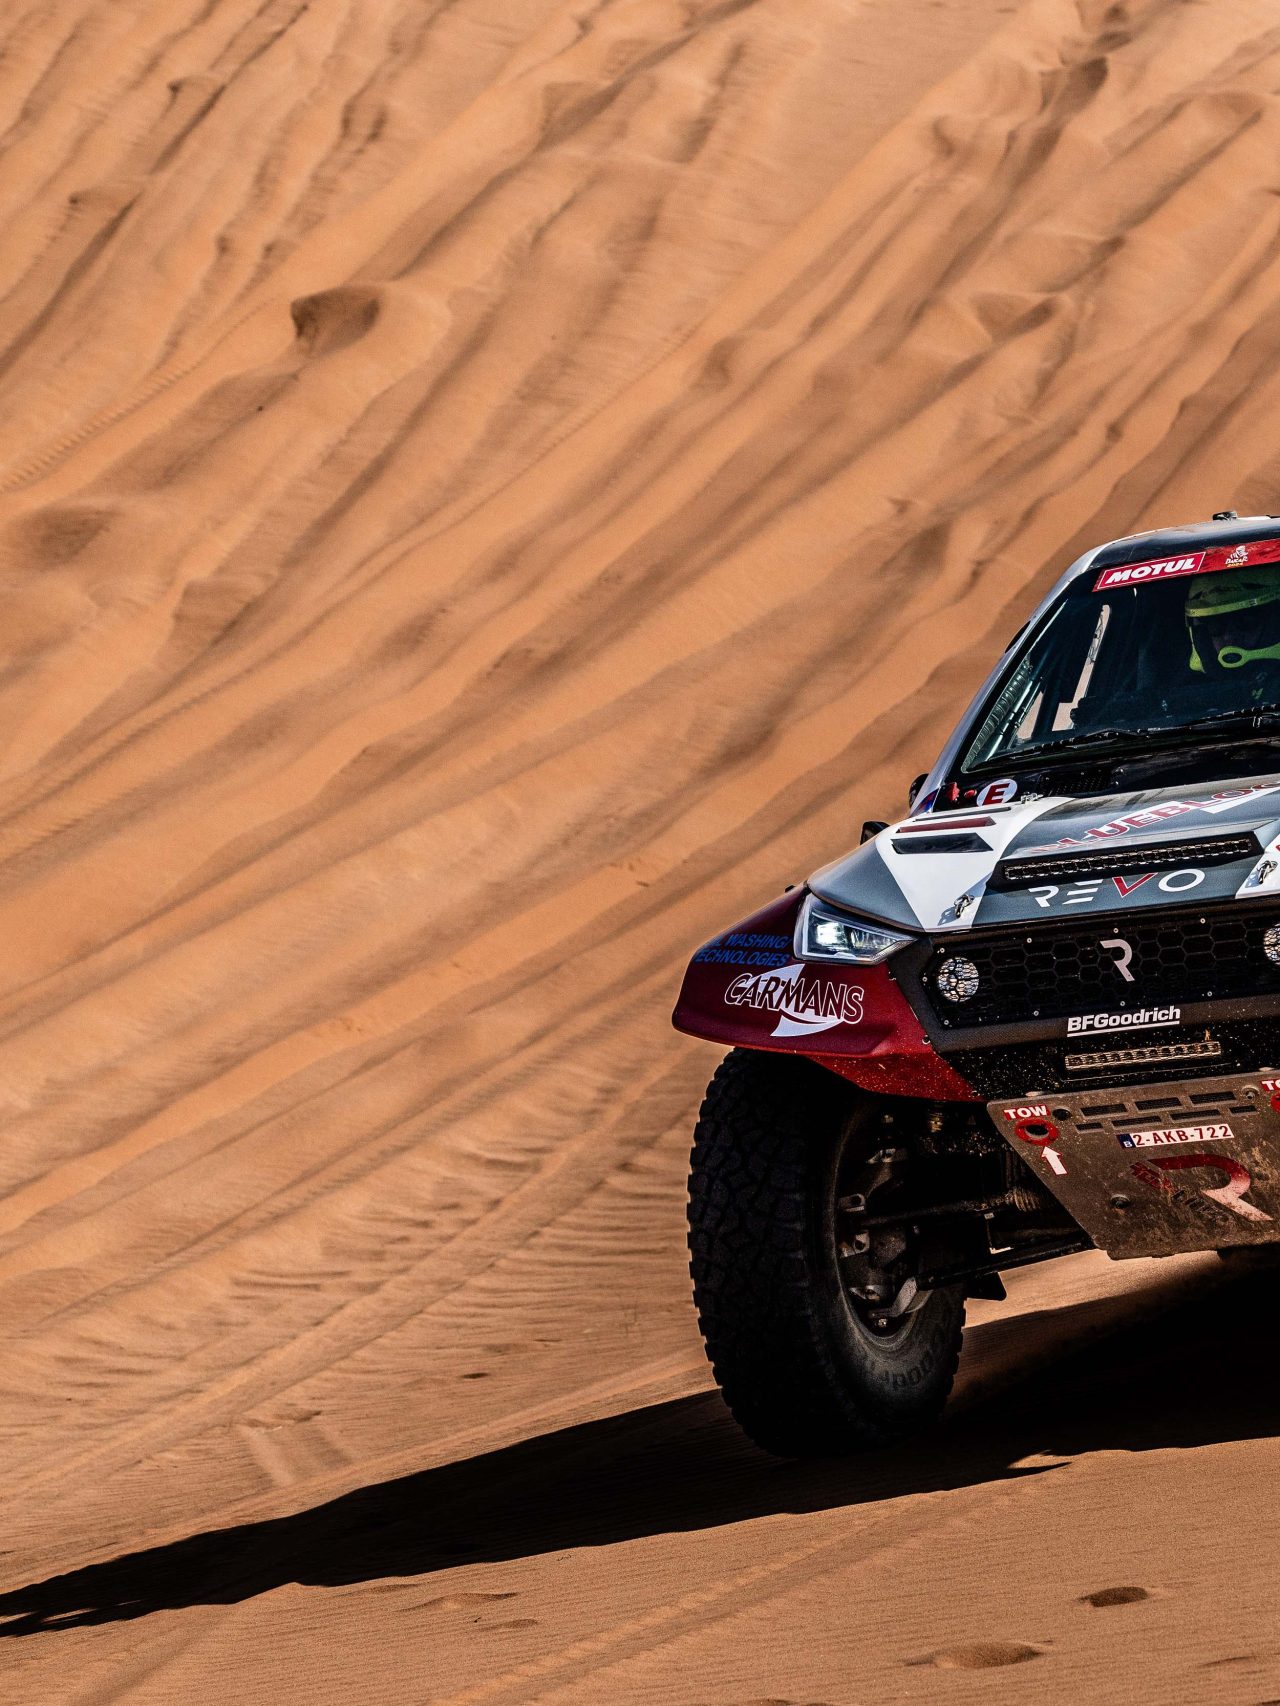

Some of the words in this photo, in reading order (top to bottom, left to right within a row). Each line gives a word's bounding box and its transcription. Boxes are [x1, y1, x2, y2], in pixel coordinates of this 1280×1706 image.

[1105, 557, 1195, 584] MOTUL
[1225, 556, 1248, 565] DAKAR
[983, 783, 1010, 805] E
[1028, 869, 1205, 908] REVO
[693, 948, 790, 967] ECHNOLOGIES
[724, 972, 864, 1024] CARMANS
[1067, 1005, 1181, 1032] BFGoodrich
[1004, 1105, 1048, 1120] TOW
[1133, 1124, 1232, 1147] 2-AKB-722
